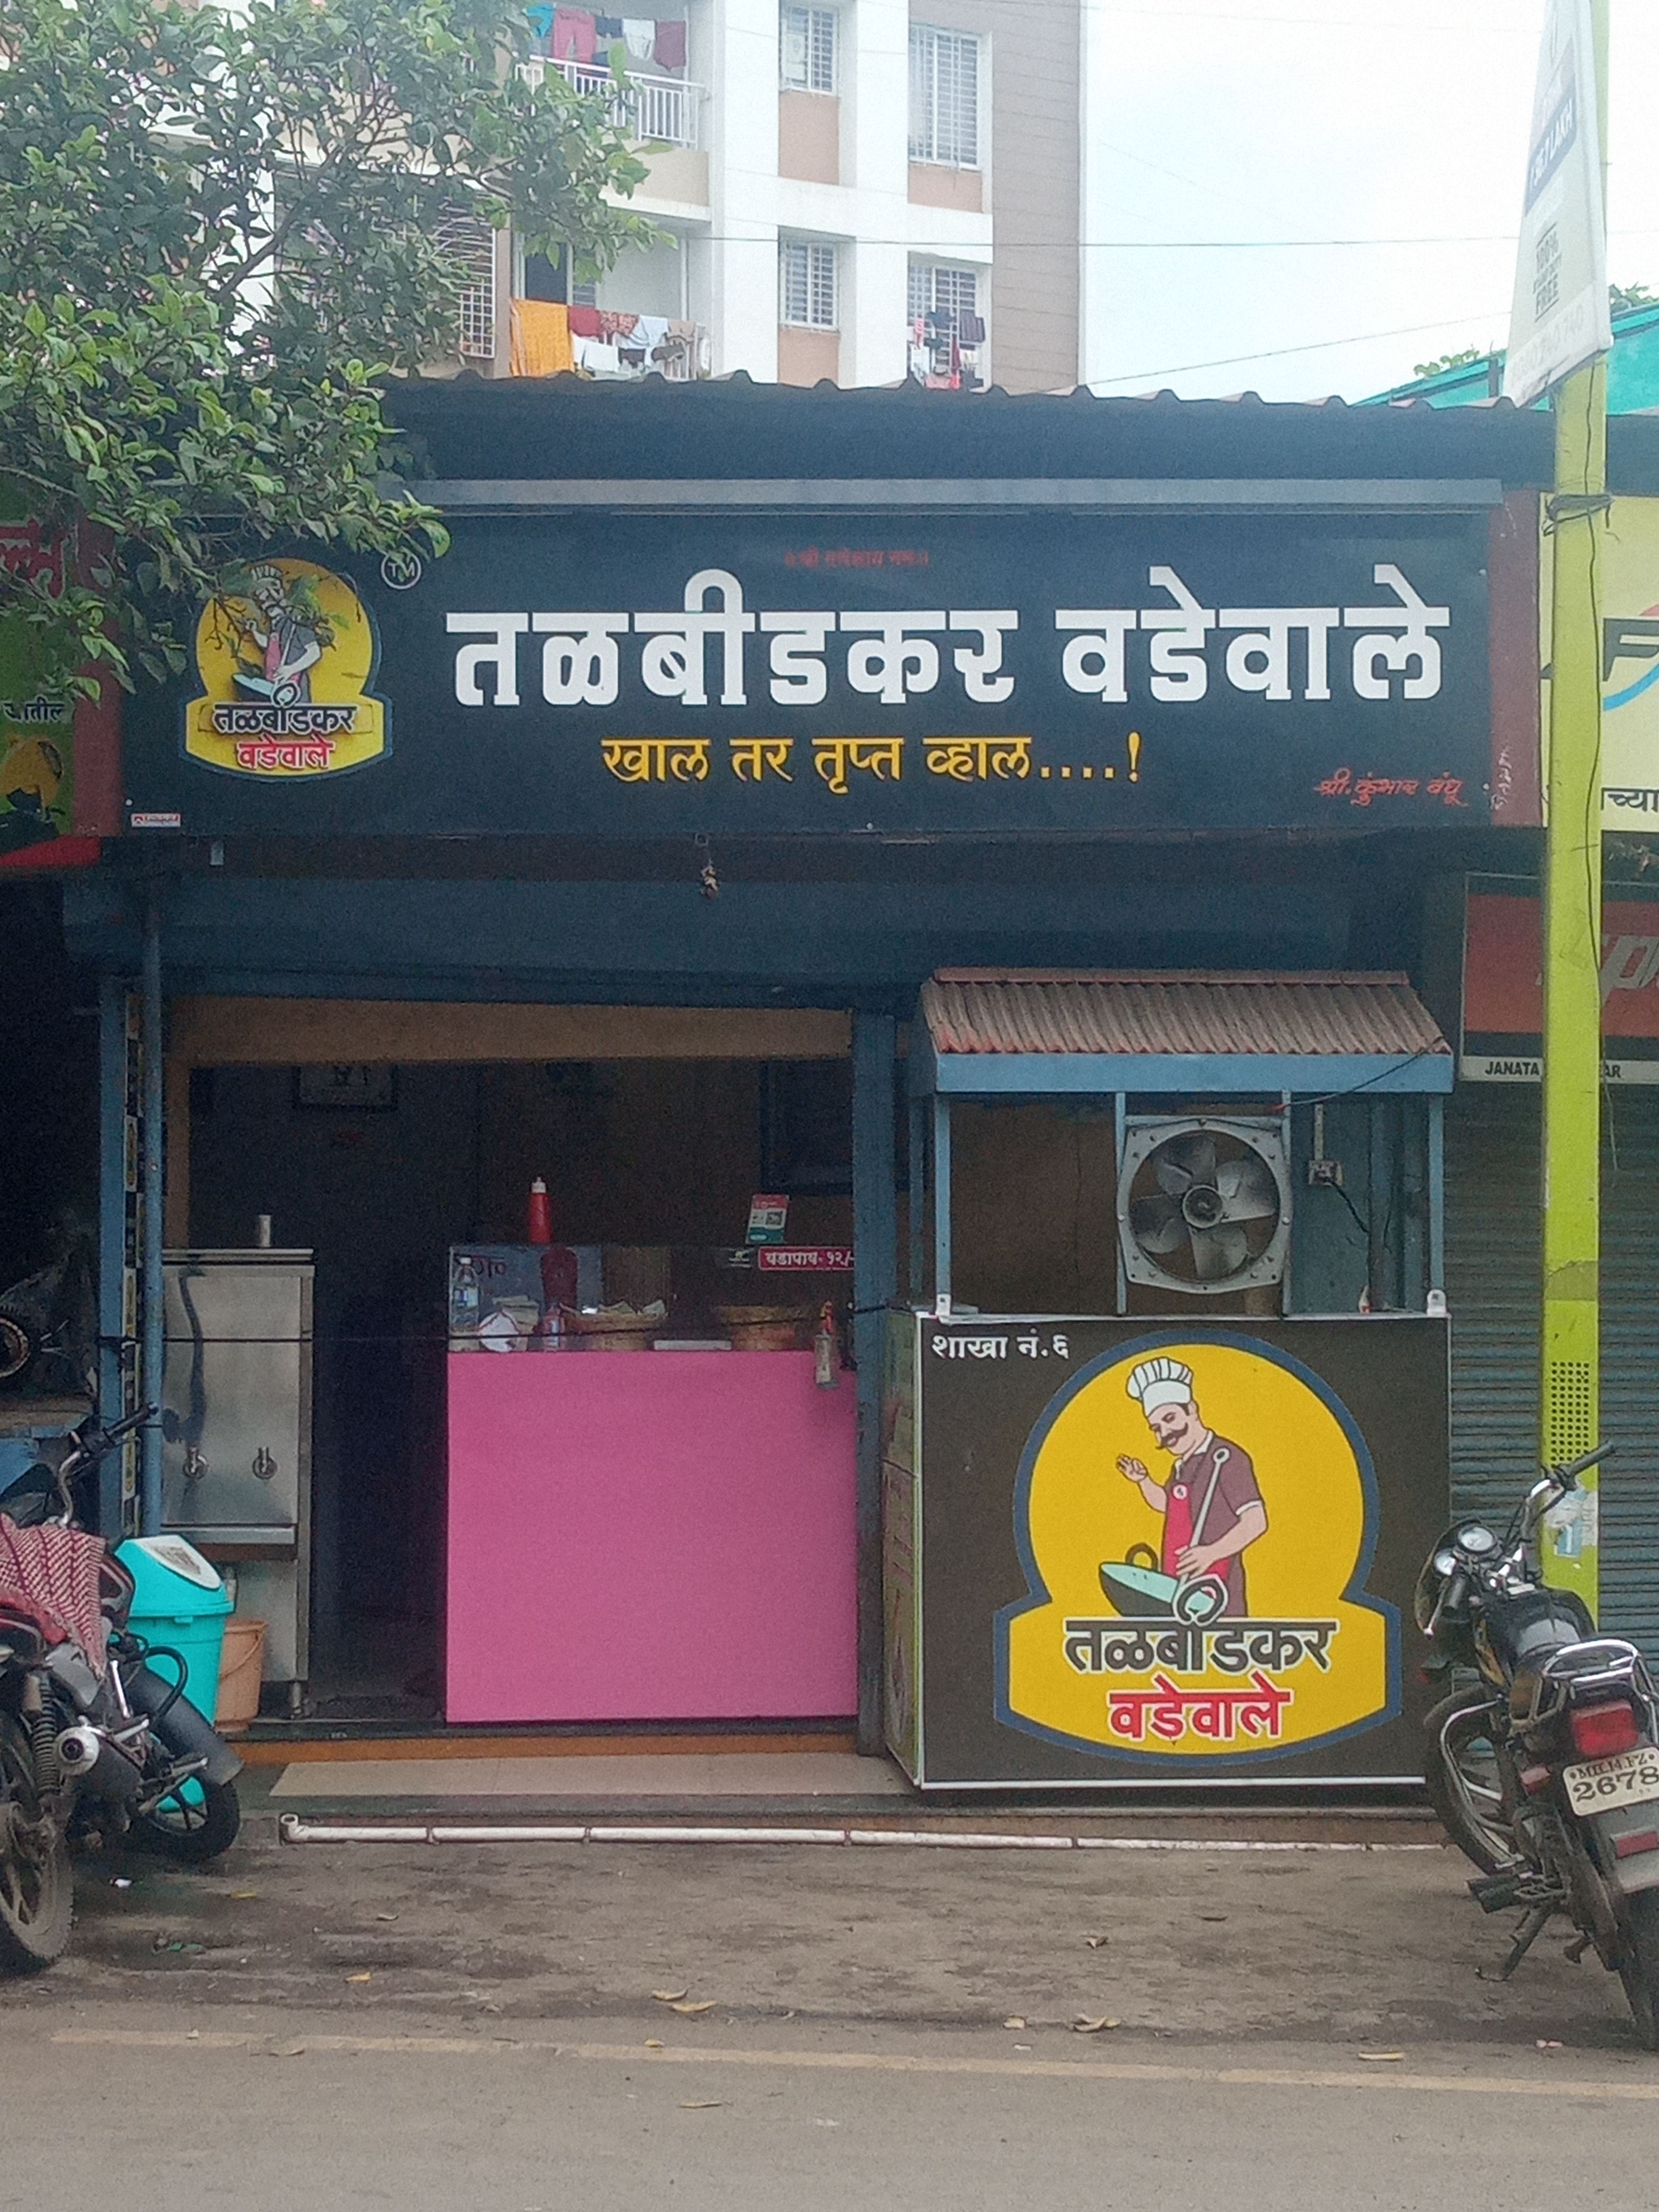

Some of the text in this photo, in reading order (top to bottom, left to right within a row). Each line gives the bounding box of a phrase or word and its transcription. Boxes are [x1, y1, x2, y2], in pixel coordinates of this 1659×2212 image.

[446, 568, 1019, 707] तळबीडकर
[1055, 565, 1451, 703] वडेवाले
[237, 733, 336, 769] वडेवाले
[601, 737, 712, 783] खाल
[730, 737, 794, 782] तर
[811, 736, 906, 795] तृप्त
[1485, 1061, 1540, 1076] JANATA
[932, 1334, 1009, 1359] शाखा
[1065, 1611, 1340, 1672] तळबीडकर
[1107, 1671, 1295, 1742] वडेवाले
[1572, 1765, 1659, 1803] 2678
